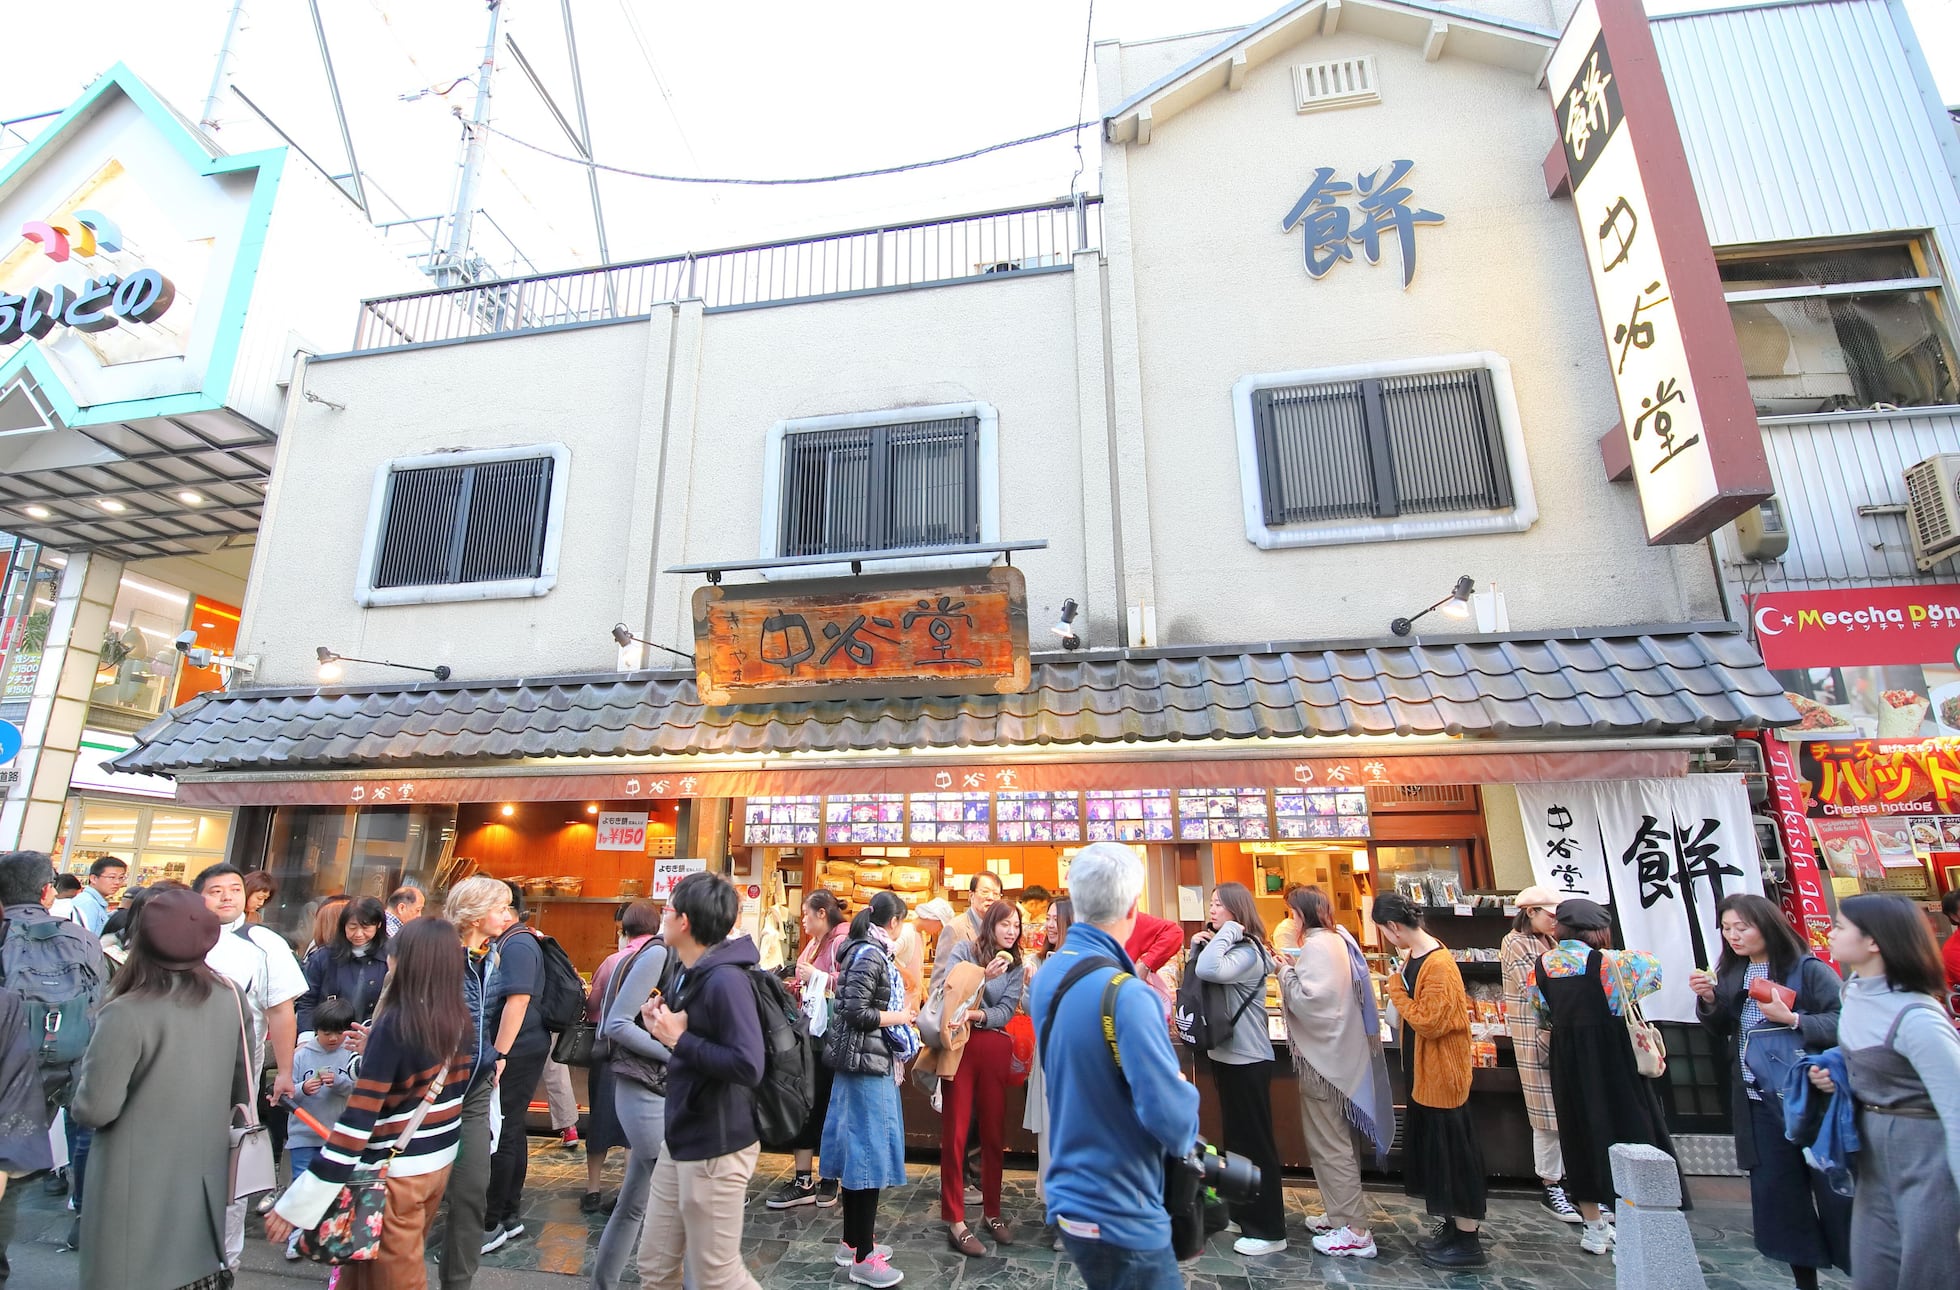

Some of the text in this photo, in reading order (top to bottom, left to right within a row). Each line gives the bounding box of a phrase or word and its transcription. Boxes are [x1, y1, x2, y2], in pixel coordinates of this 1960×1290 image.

[1600, 196, 1699, 474] 中谷堂
[1797, 604, 1960, 632] Meccha Dön
[760, 597, 983, 675] 中谷堂
[1812, 741, 1874, 759] チーズ
[935, 769, 1019, 789] 中谷堂
[1293, 762, 1391, 783] 中谷堂
[1819, 755, 1960, 801] ハット
[350, 783, 415, 802] 中谷堂
[625, 776, 698, 796] 中谷堂
[1823, 801, 1933, 815] Cheese hotdog
[1770, 750, 1818, 871] Turkish
[1798, 880, 1821, 913] Ic
[1546, 804, 1590, 895] 中谷堂
